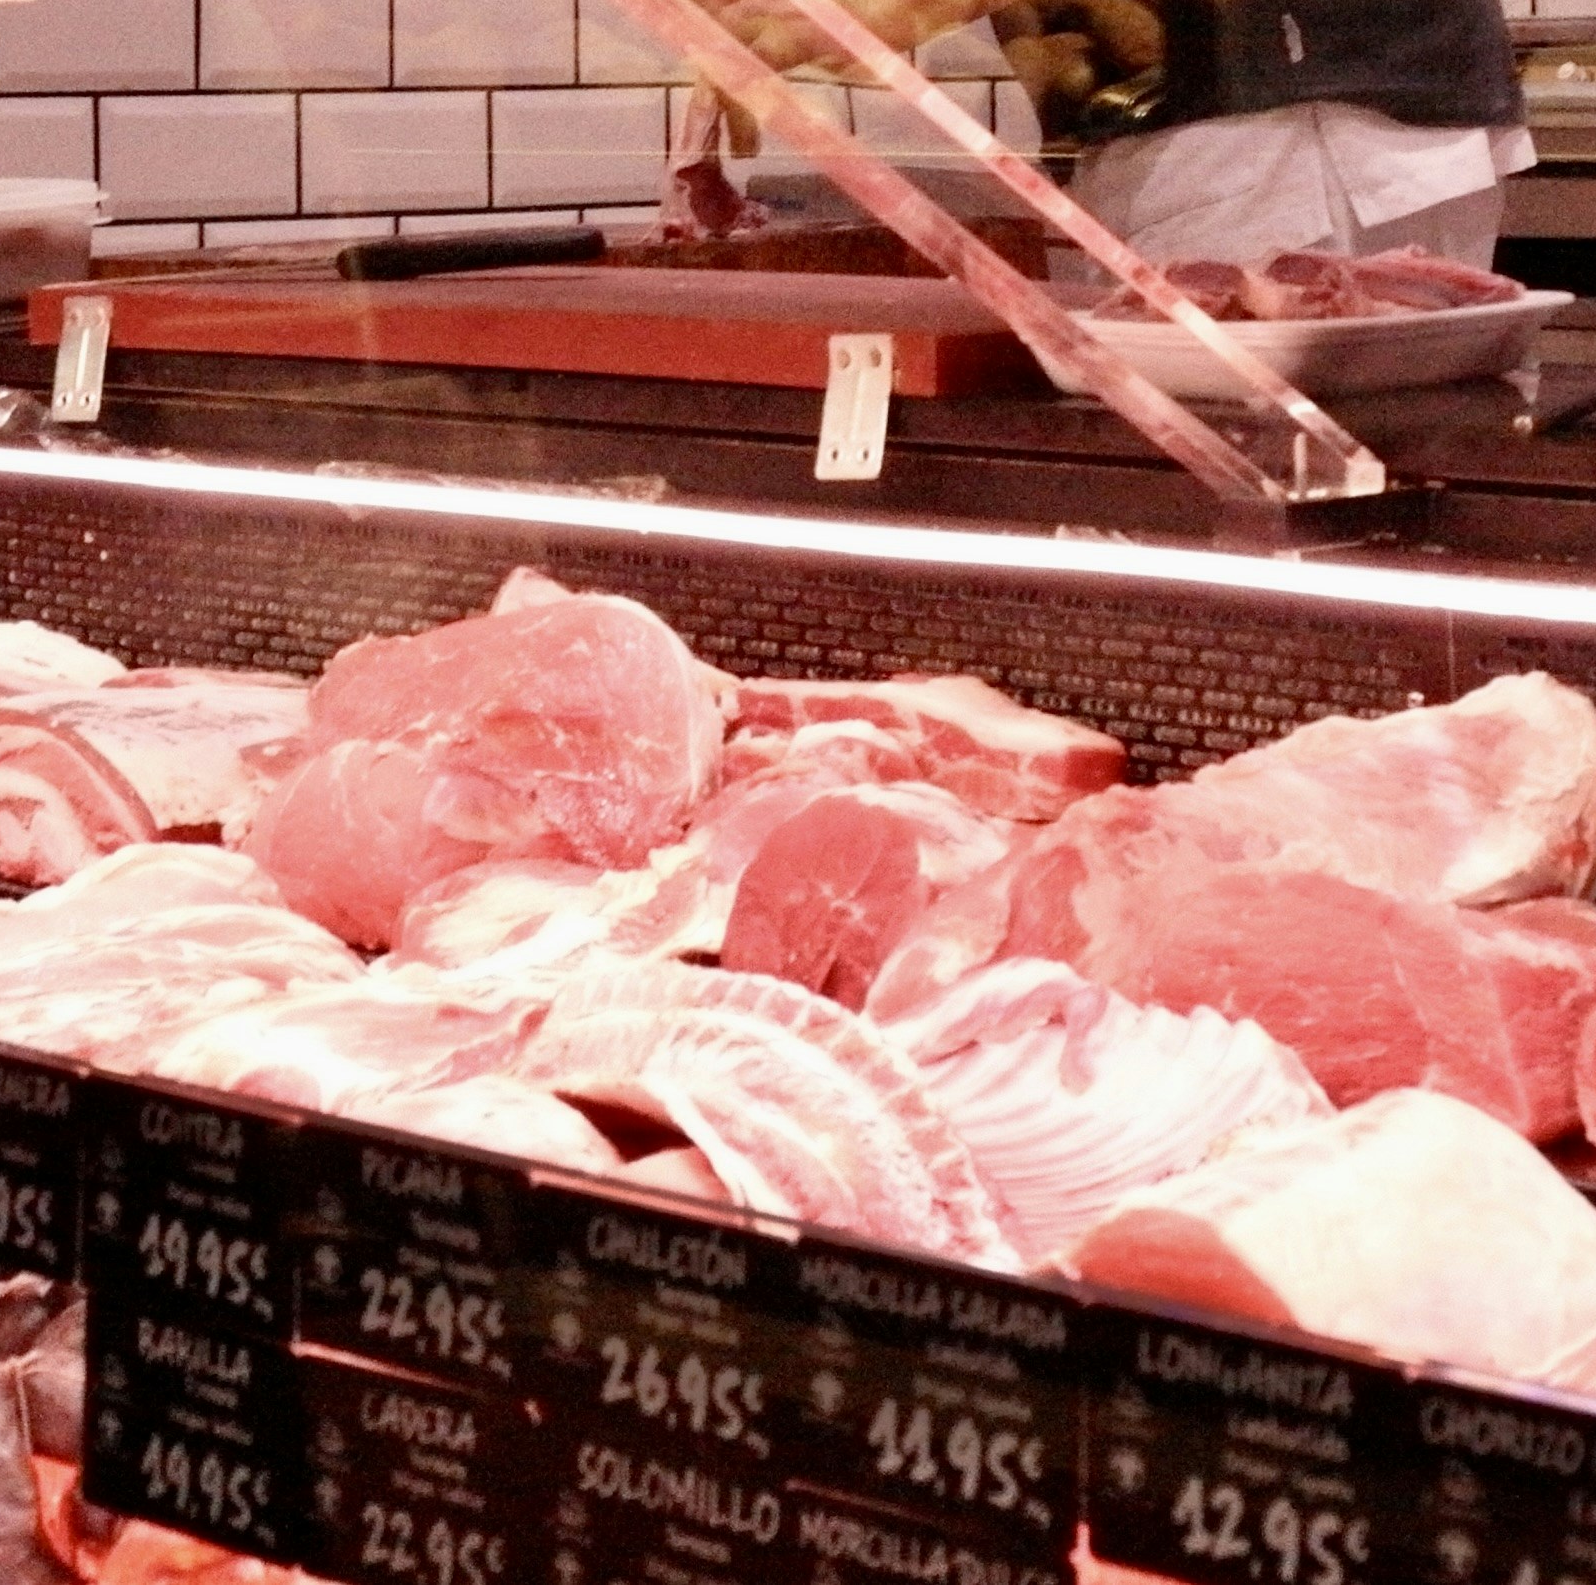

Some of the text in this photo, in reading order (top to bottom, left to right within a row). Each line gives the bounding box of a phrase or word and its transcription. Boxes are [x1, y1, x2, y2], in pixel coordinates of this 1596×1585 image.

[798, 1256, 944, 1320] MORCILLA
[360, 1391, 477, 1454] CADERA
[1419, 1396, 1586, 1475] CHORIZO
[577, 1442, 780, 1544] SOLOMILLO
[798, 1510, 949, 1582] MORCILLA
